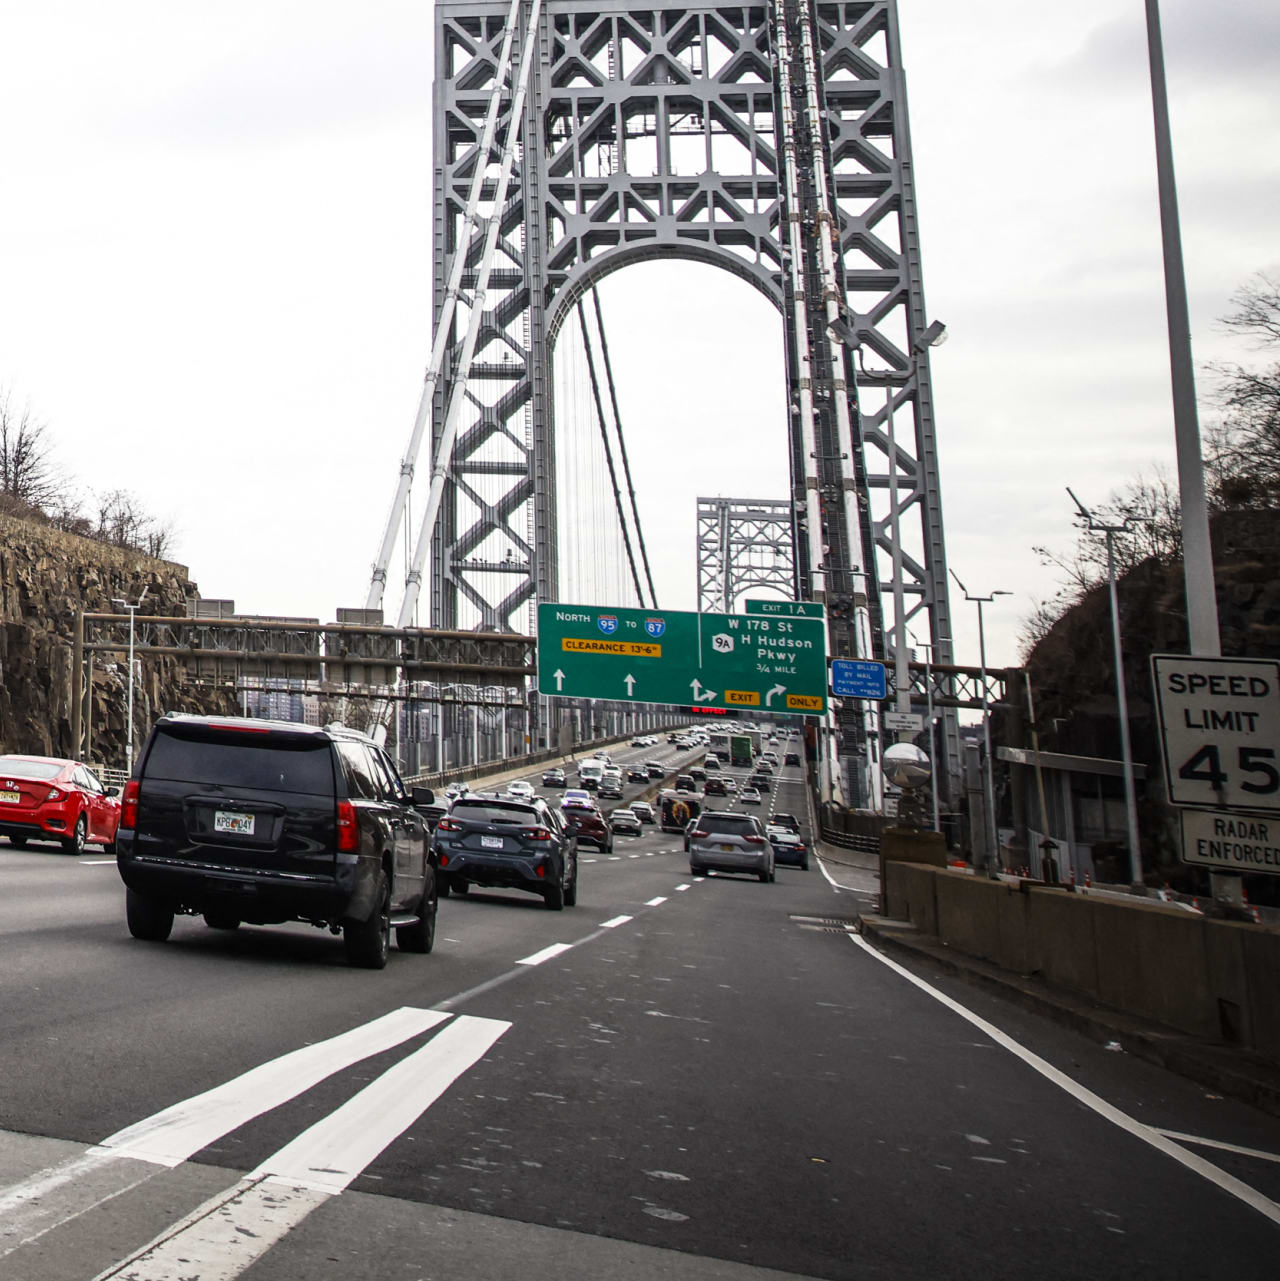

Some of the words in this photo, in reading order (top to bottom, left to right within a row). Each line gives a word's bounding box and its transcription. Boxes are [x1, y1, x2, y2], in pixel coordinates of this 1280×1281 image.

[762, 604, 781, 612] EXIT
[556, 611, 591, 622] NORTH
[600, 620, 615, 630] 95
[625, 620, 637, 628] TO
[648, 623, 662, 633] 87
[728, 619, 739, 629] W
[747, 620, 770, 631] 178
[777, 622, 793, 633] St
[565, 641, 625, 652] CLEARANCE
[715, 637, 730, 649] 9A
[741, 634, 751, 645] H
[758, 635, 812, 648] Hudson
[757, 648, 796, 663] Pkwy
[775, 666, 797, 674] MILE
[1168, 673, 1270, 697] SPEED
[730, 693, 753, 702] EXIT
[790, 697, 818, 707] ONLY
[1184, 708, 1259, 733] LIMIT
[1179, 744, 1280, 795] 45
[1214, 817, 1269, 842] RADAR
[1197, 839, 1280, 866] ENFORCED
